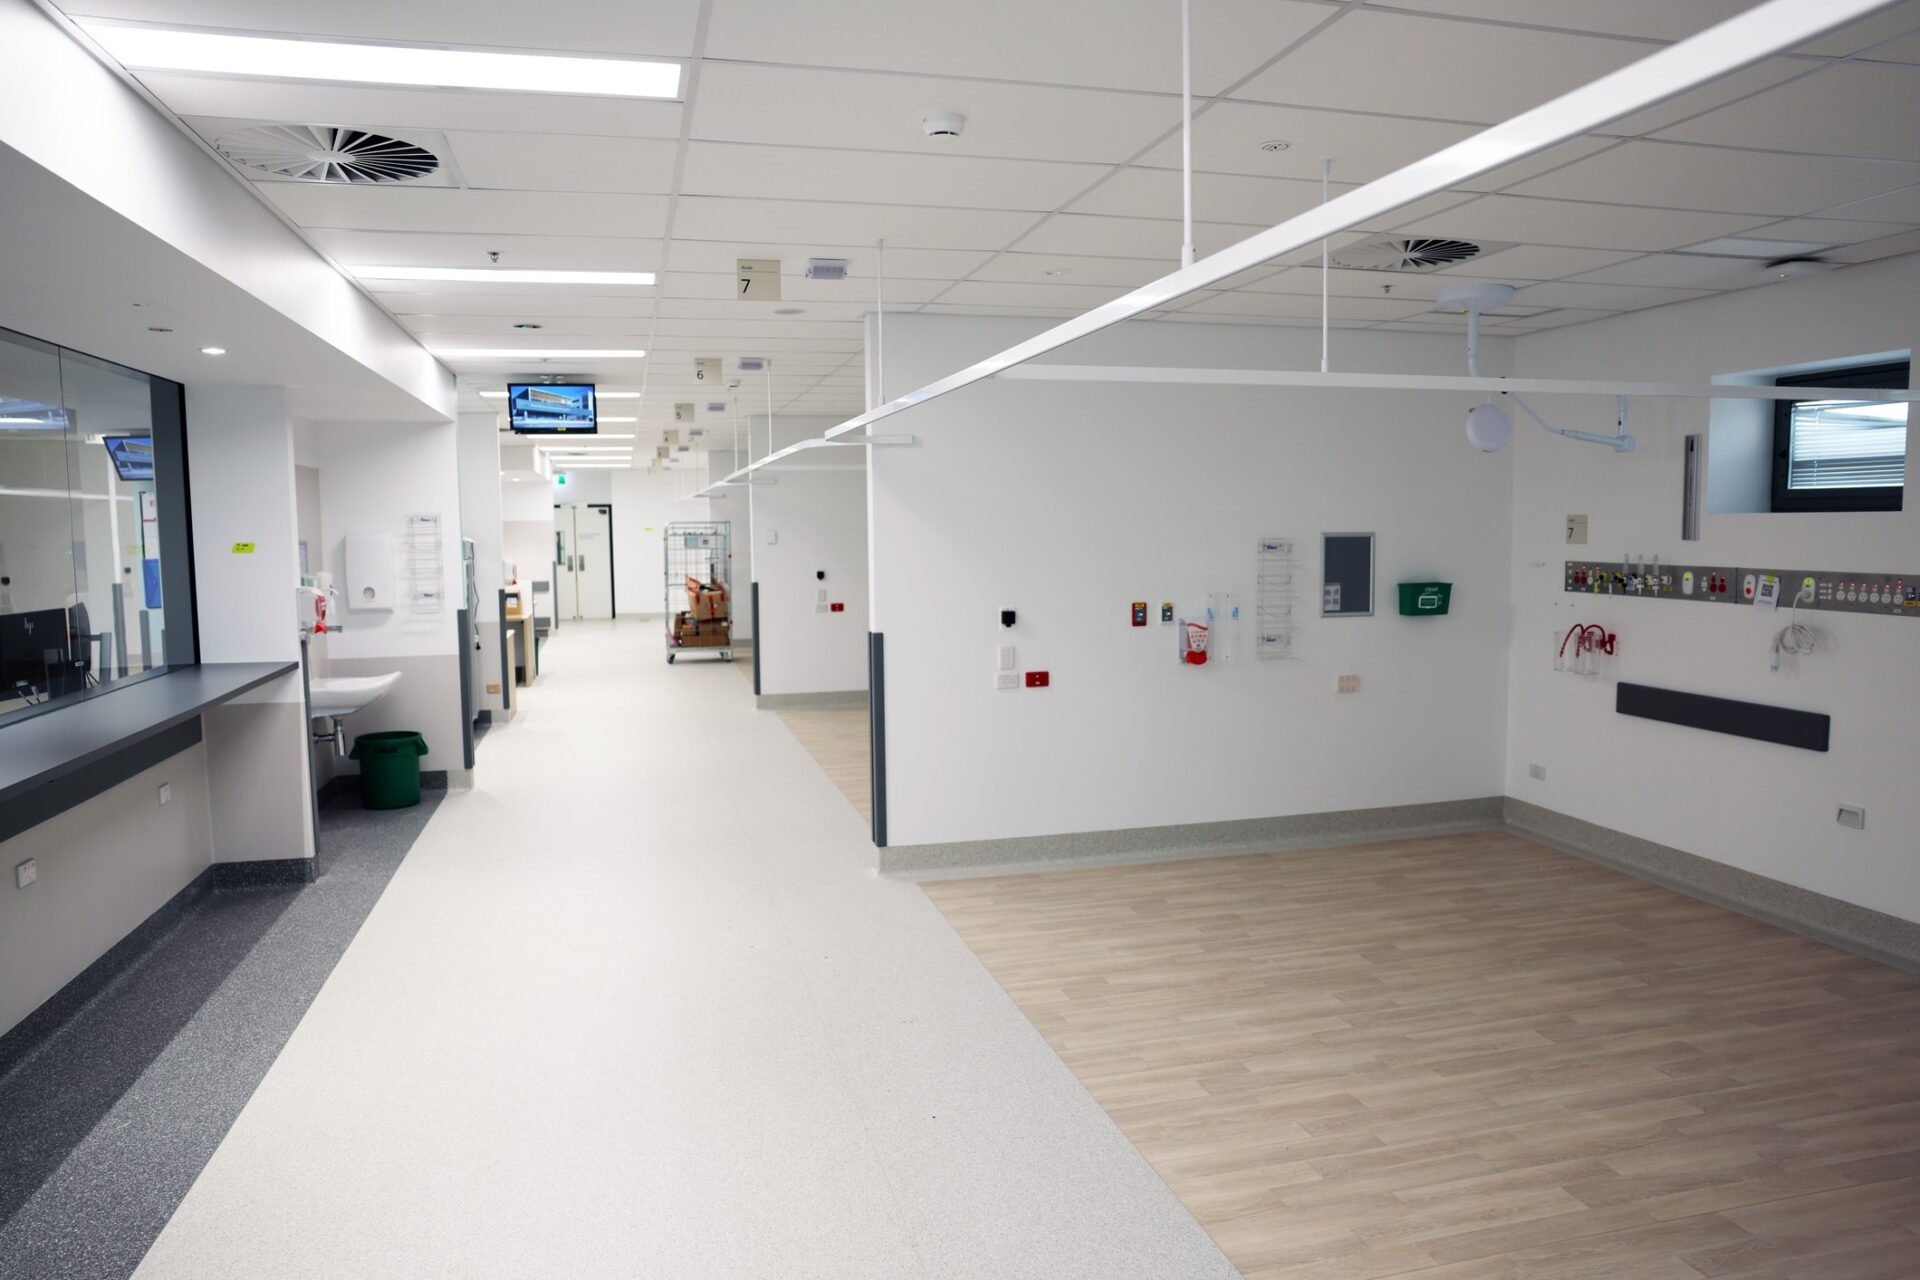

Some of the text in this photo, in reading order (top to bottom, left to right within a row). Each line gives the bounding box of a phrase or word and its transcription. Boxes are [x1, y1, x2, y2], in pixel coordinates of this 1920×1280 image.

[741, 278, 751, 294] 7
[696, 370, 704, 380] 6
[676, 412, 682, 420] 5
[1568, 527, 1574, 539] 7
[23, 616, 34, 636] hp
